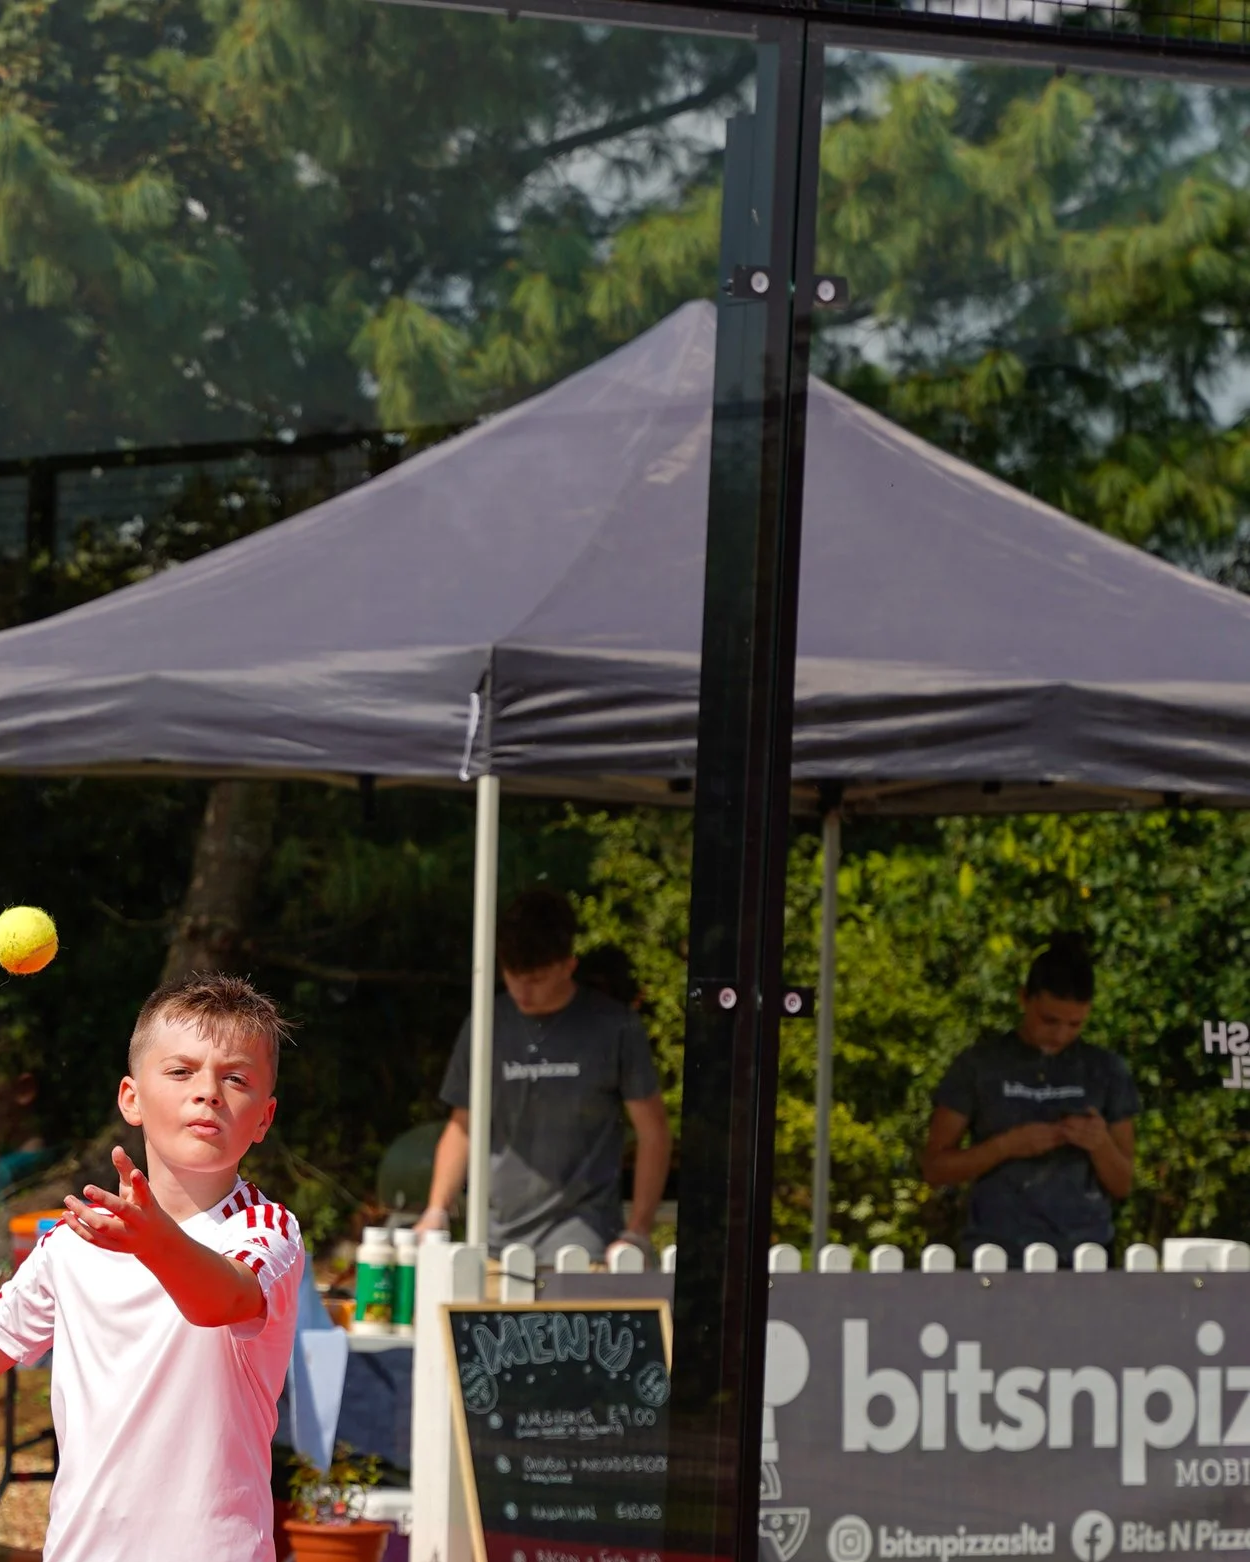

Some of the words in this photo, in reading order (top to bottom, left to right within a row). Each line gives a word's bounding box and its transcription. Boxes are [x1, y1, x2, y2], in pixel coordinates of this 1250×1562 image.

[472, 1312, 635, 1375] MENU
[1121, 1523, 1166, 1553] Bits
[1170, 1520, 1191, 1552] N
